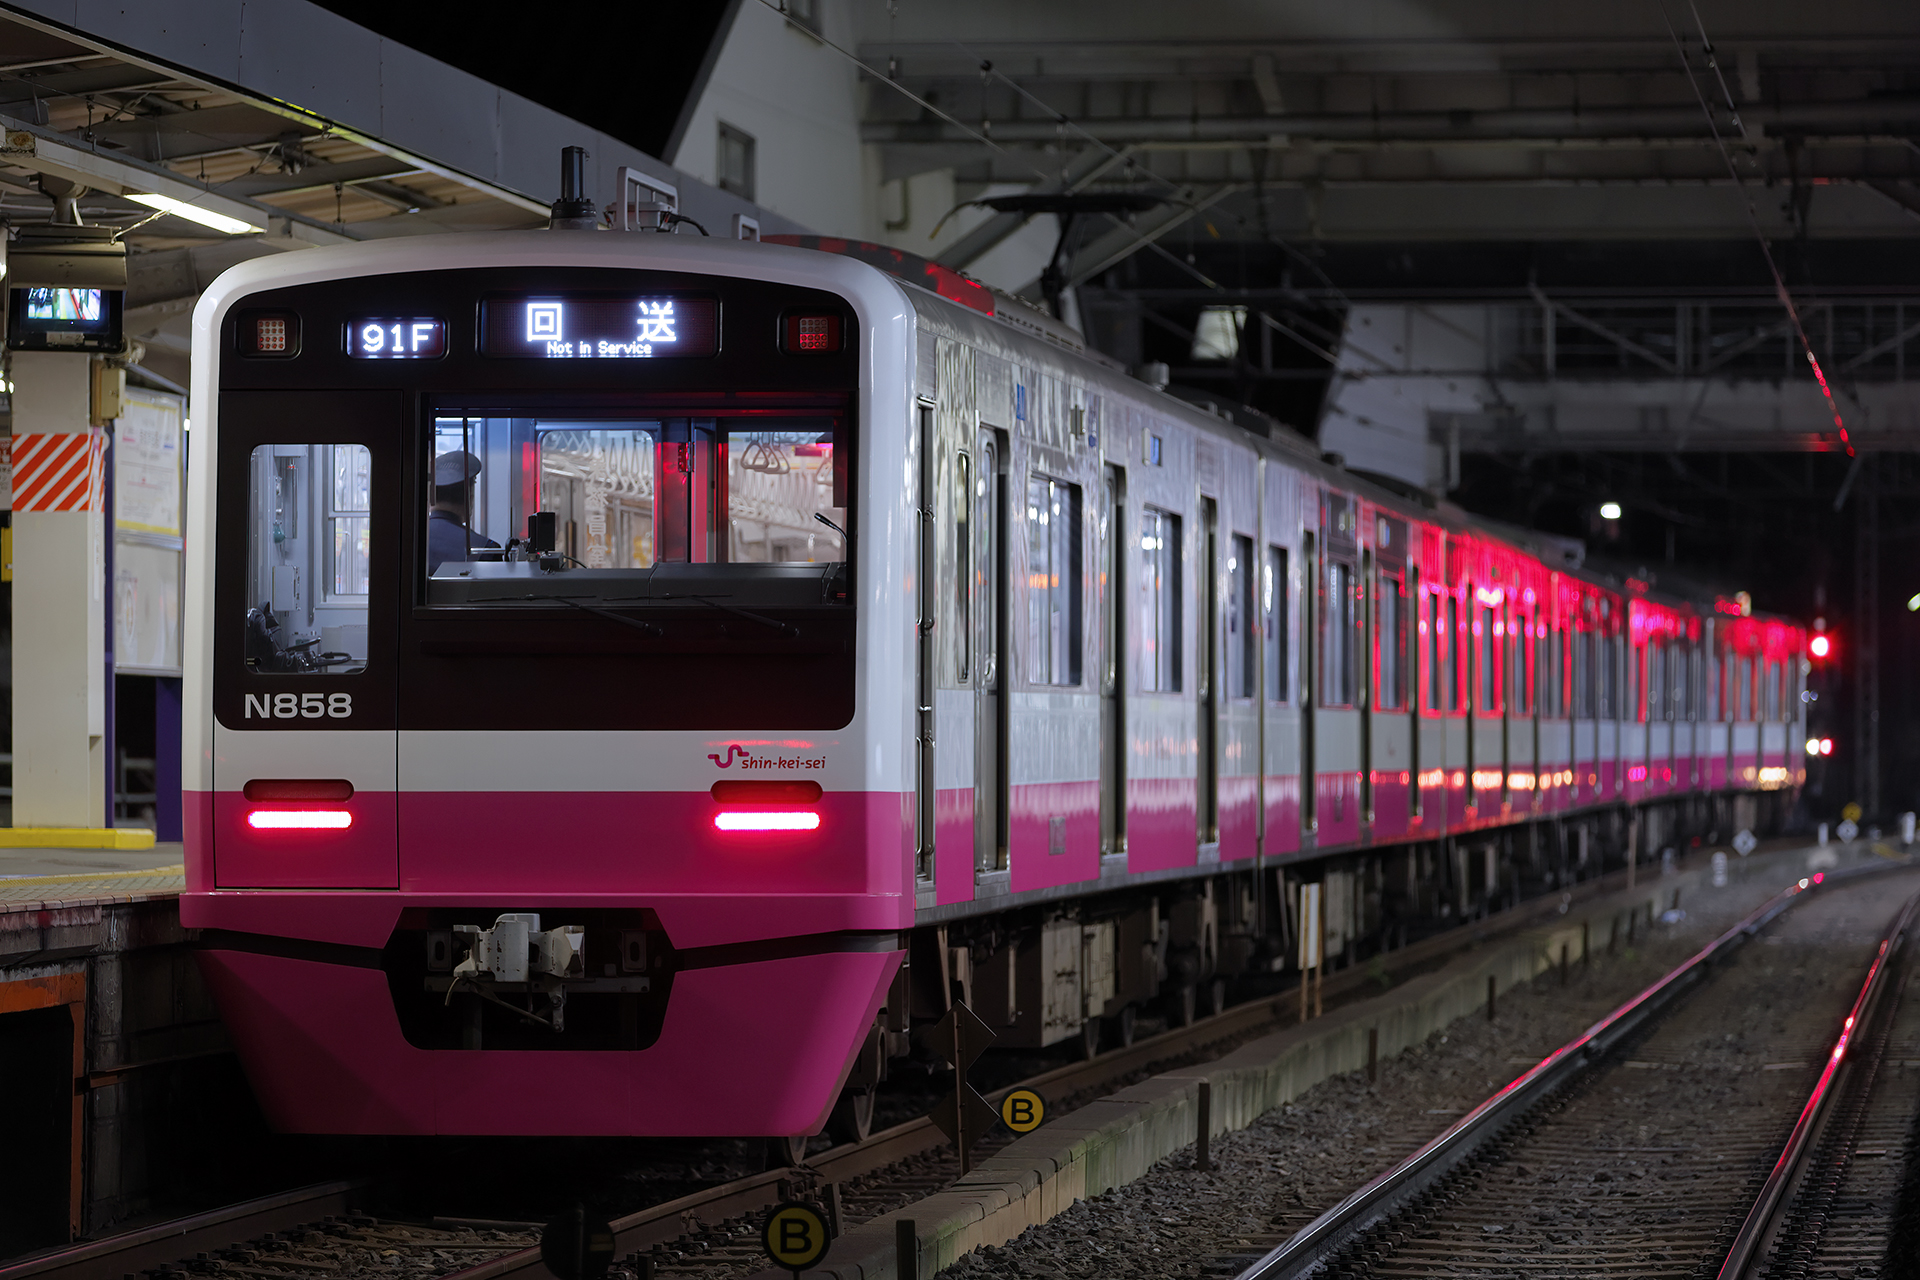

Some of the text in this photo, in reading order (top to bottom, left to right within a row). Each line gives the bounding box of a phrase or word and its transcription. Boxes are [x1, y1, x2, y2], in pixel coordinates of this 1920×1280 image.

[526, 301, 677, 342] 回送
[363, 324, 434, 351] 91F
[547, 341, 652, 354] Not in Service
[244, 693, 352, 719] N858
[741, 756, 826, 769] shin-kei-sei
[1011, 1098, 1034, 1125] B
[780, 1218, 812, 1254] B
